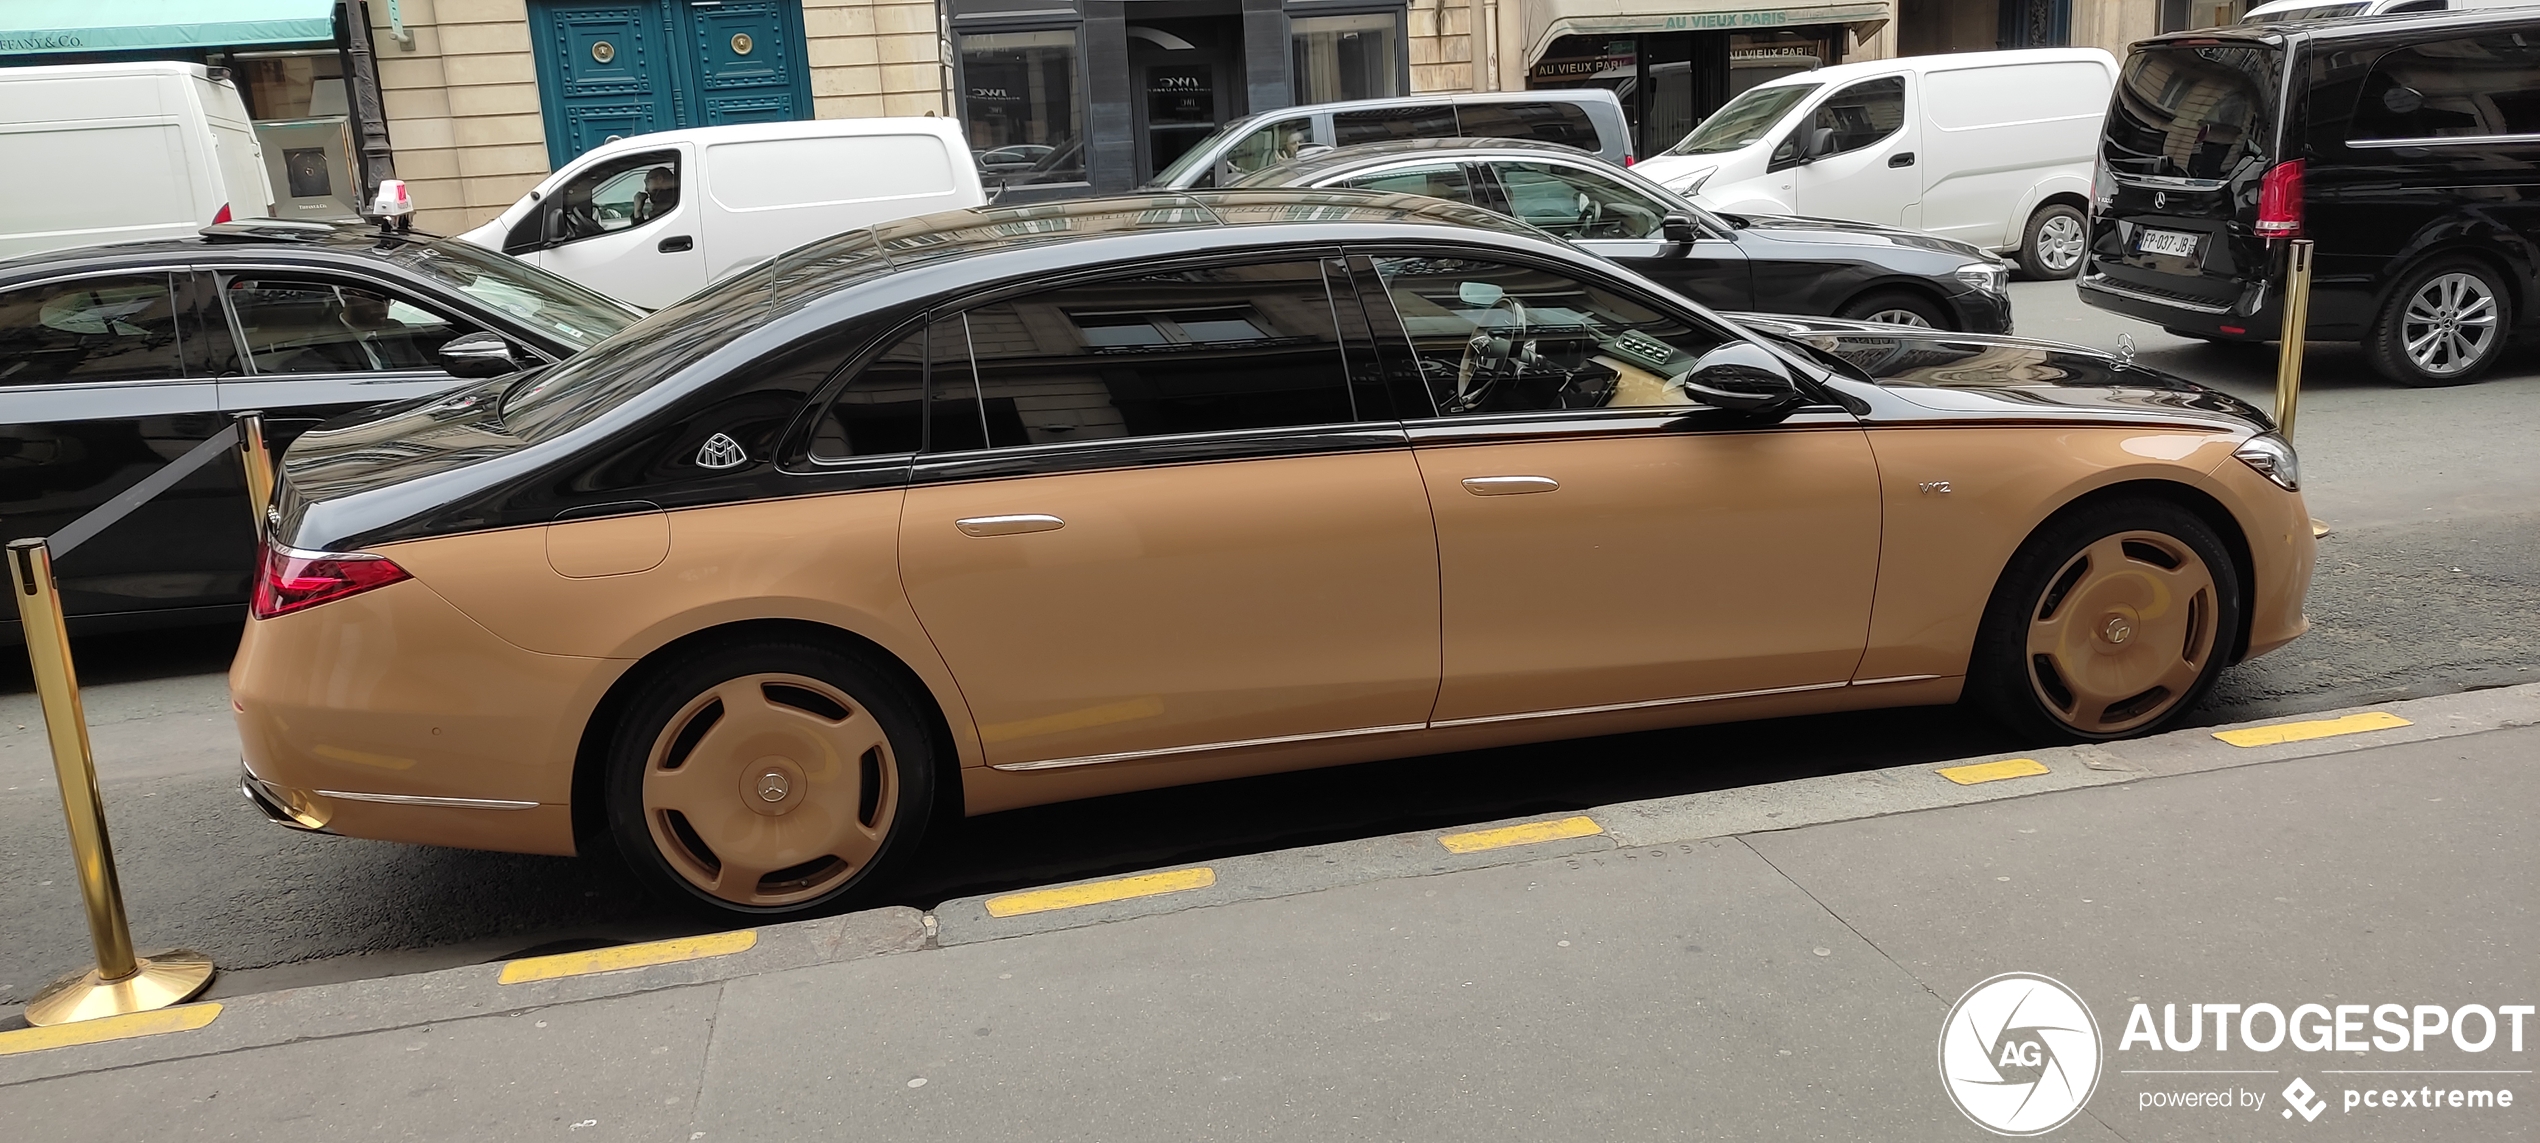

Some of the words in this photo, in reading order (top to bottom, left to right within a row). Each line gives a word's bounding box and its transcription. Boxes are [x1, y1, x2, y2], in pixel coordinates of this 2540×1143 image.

[1665, 16, 1687, 30] AU
[1693, 14, 1737, 29] VIEUX
[1742, 12, 1786, 26] PARIS
[45, 36, 56, 48] &
[1745, 48, 1779, 60] VIEUX
[1782, 46, 1815, 57] PARIS
[1538, 64, 1555, 76] AU
[1558, 62, 1592, 74] VIEUX
[1595, 60, 1627, 72] PARI
